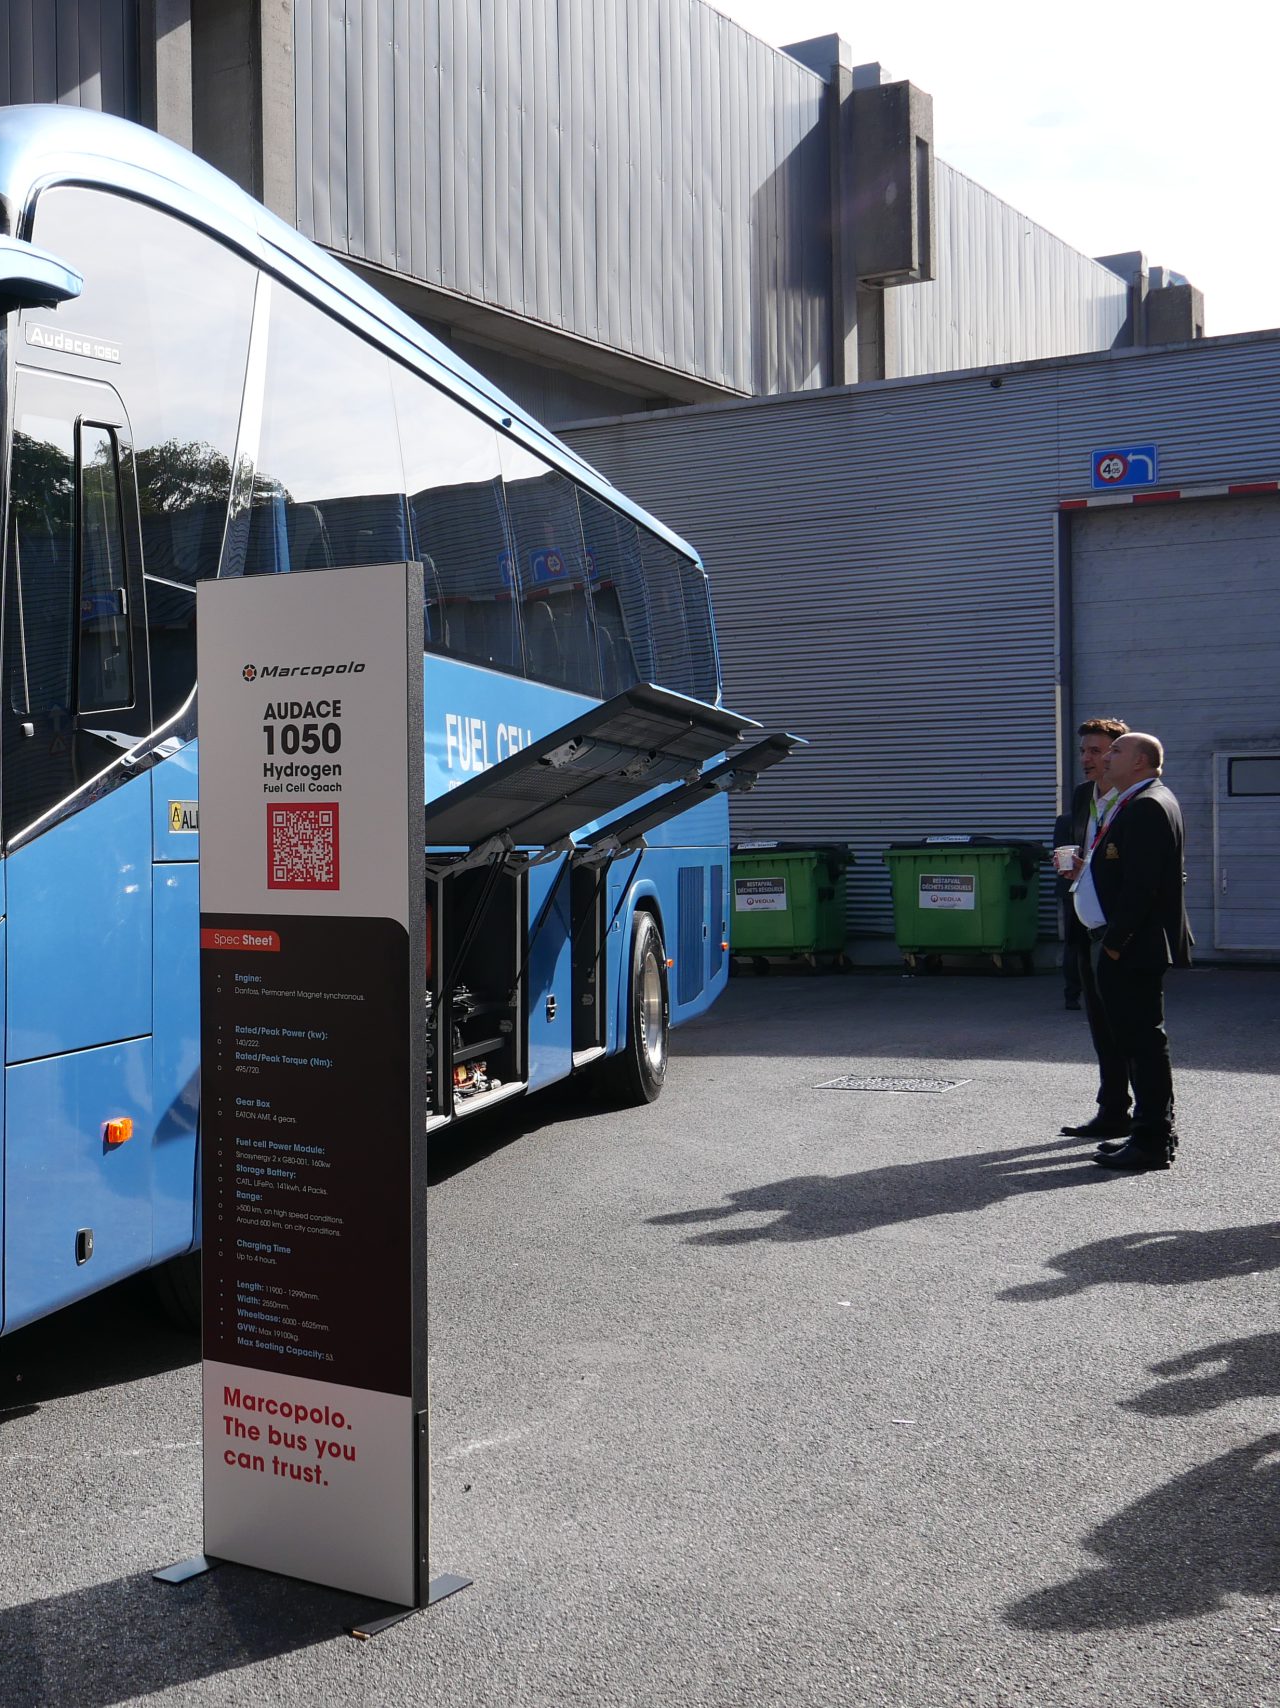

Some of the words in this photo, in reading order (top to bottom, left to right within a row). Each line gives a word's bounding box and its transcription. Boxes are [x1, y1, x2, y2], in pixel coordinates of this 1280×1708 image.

[31, 327, 91, 355] Audace
[94, 345, 119, 361] 1050
[1103, 463, 1111, 474] 4
[260, 660, 366, 679] Marcopolo
[263, 699, 342, 720] AUDACE
[263, 722, 342, 756] 1050
[445, 713, 494, 772] FUEL
[263, 762, 342, 781] Hydrogen
[263, 782, 283, 793] Fuel
[286, 782, 306, 793] Cell
[309, 781, 342, 793] Coach
[214, 934, 240, 947] Spec
[242, 935, 273, 946] Sheet
[235, 973, 262, 983] Engine:
[261, 988, 296, 997] Permanent
[297, 991, 322, 999] Magnet
[235, 1026, 280, 1036] Rated/Peak
[282, 1029, 305, 1037] Power
[307, 1030, 328, 1040] (kw):
[235, 1052, 280, 1063] Rated/Peak
[282, 1056, 307, 1065] Torque
[310, 1057, 333, 1068] (Nm):
[236, 1097, 254, 1107] Gear
[256, 1099, 271, 1108] Box
[236, 1111, 256, 1120] EATON
[236, 1138, 251, 1147] Fuel
[253, 1140, 267, 1149] cell
[269, 1142, 291, 1151] Power
[294, 1144, 325, 1155] Module:
[236, 1151, 270, 1163] Sinosynergy
[236, 1164, 264, 1175] Storage
[267, 1167, 296, 1179] Battery:
[236, 1190, 263, 1202] Range:
[274, 1209, 287, 1219] high
[288, 1211, 308, 1221] speed
[237, 1216, 258, 1226] Around
[294, 1224, 306, 1233] city
[237, 1239, 271, 1253] Charging
[273, 1244, 291, 1254] Time
[237, 1253, 245, 1261] Up
[237, 1280, 264, 1293] Length:
[237, 1294, 261, 1305] Width:
[237, 1308, 281, 1323] Wheelbase:
[237, 1323, 257, 1333] GVW:
[258, 1327, 272, 1336] Max
[238, 1337, 253, 1346] Max
[255, 1340, 284, 1354] Seating
[286, 1345, 324, 1360] Capacity:
[223, 1386, 352, 1430] Marcopolo.
[223, 1415, 261, 1441] The
[269, 1425, 307, 1451] bus
[315, 1438, 356, 1462] you
[224, 1449, 265, 1472] can
[272, 1455, 329, 1486] trust.
